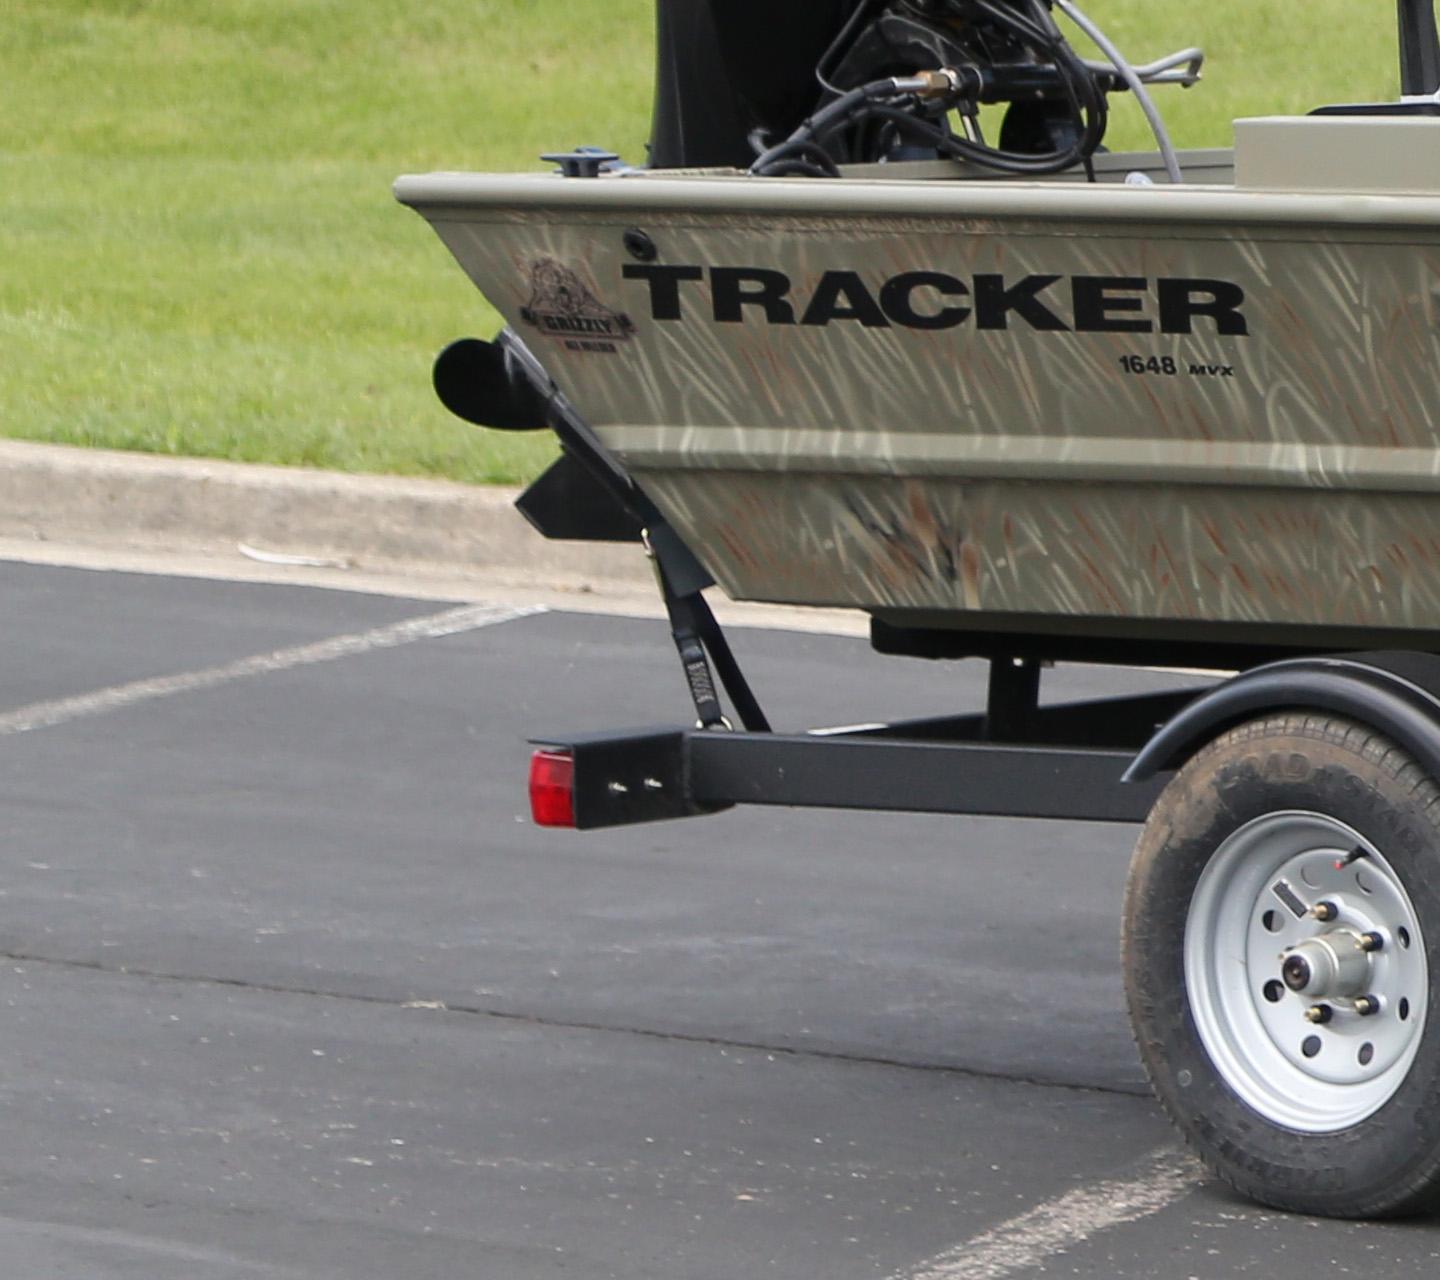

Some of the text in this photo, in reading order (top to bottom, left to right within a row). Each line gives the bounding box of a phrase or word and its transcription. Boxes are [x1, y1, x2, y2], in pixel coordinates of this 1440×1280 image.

[622, 264, 1250, 336] TRACKER
[543, 315, 612, 334] GRIZZLY
[1119, 355, 1234, 377] 1648 MVX
